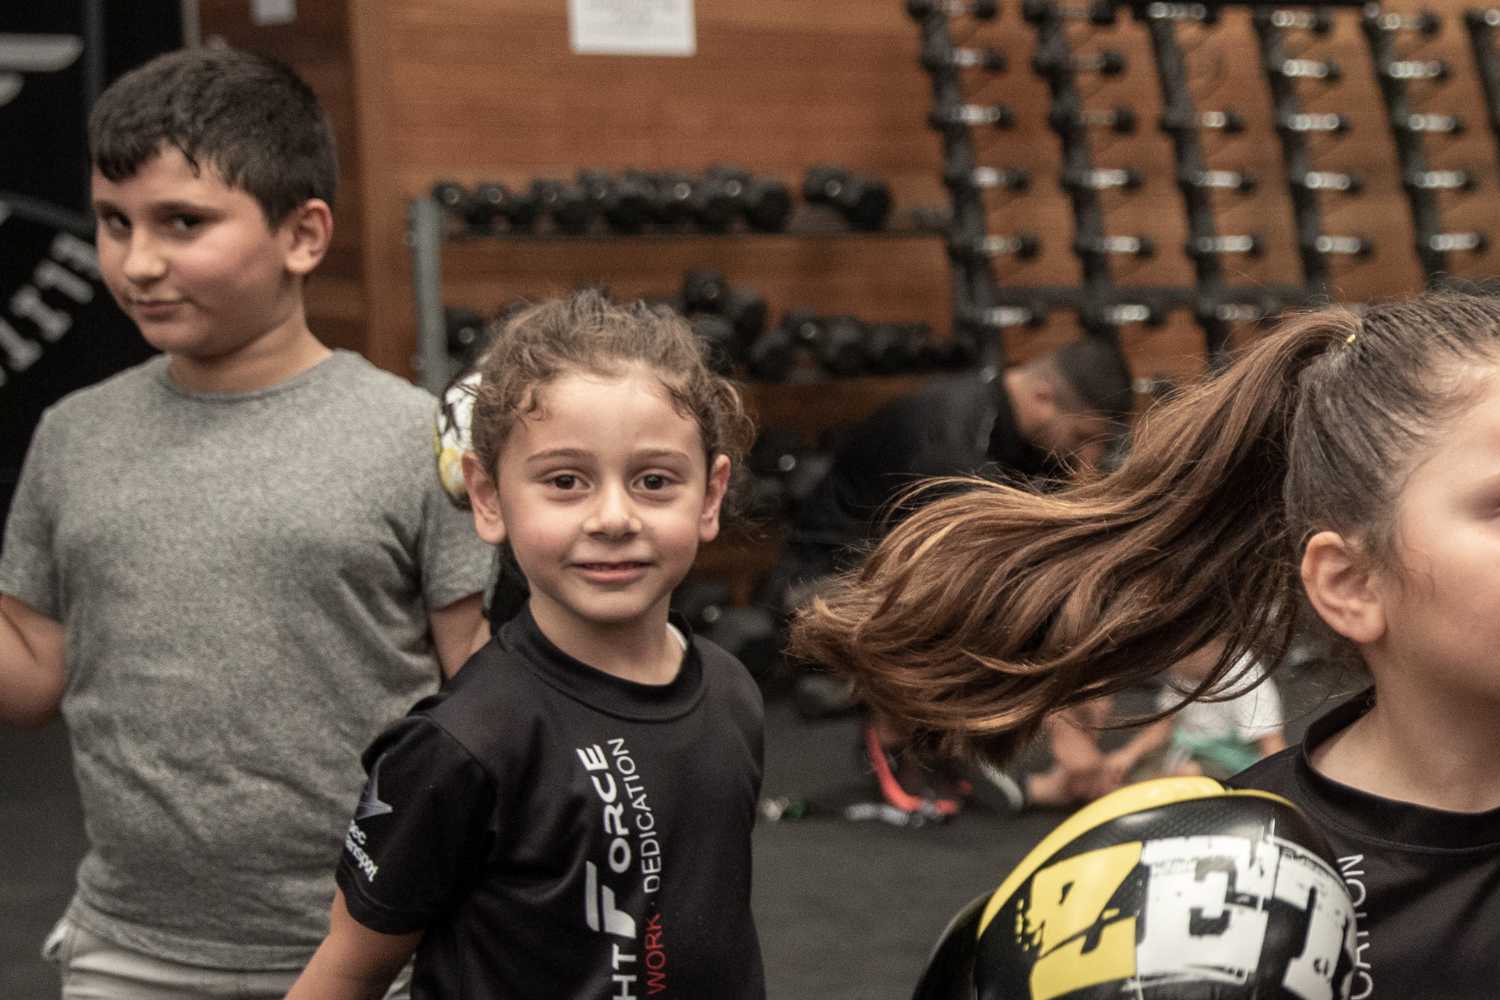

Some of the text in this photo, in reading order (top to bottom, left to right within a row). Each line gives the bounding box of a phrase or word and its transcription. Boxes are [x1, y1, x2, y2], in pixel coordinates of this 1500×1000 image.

[576, 742, 638, 938] FORCE
[606, 737, 662, 894] DEDICATION
[644, 912, 668, 996] WORK
